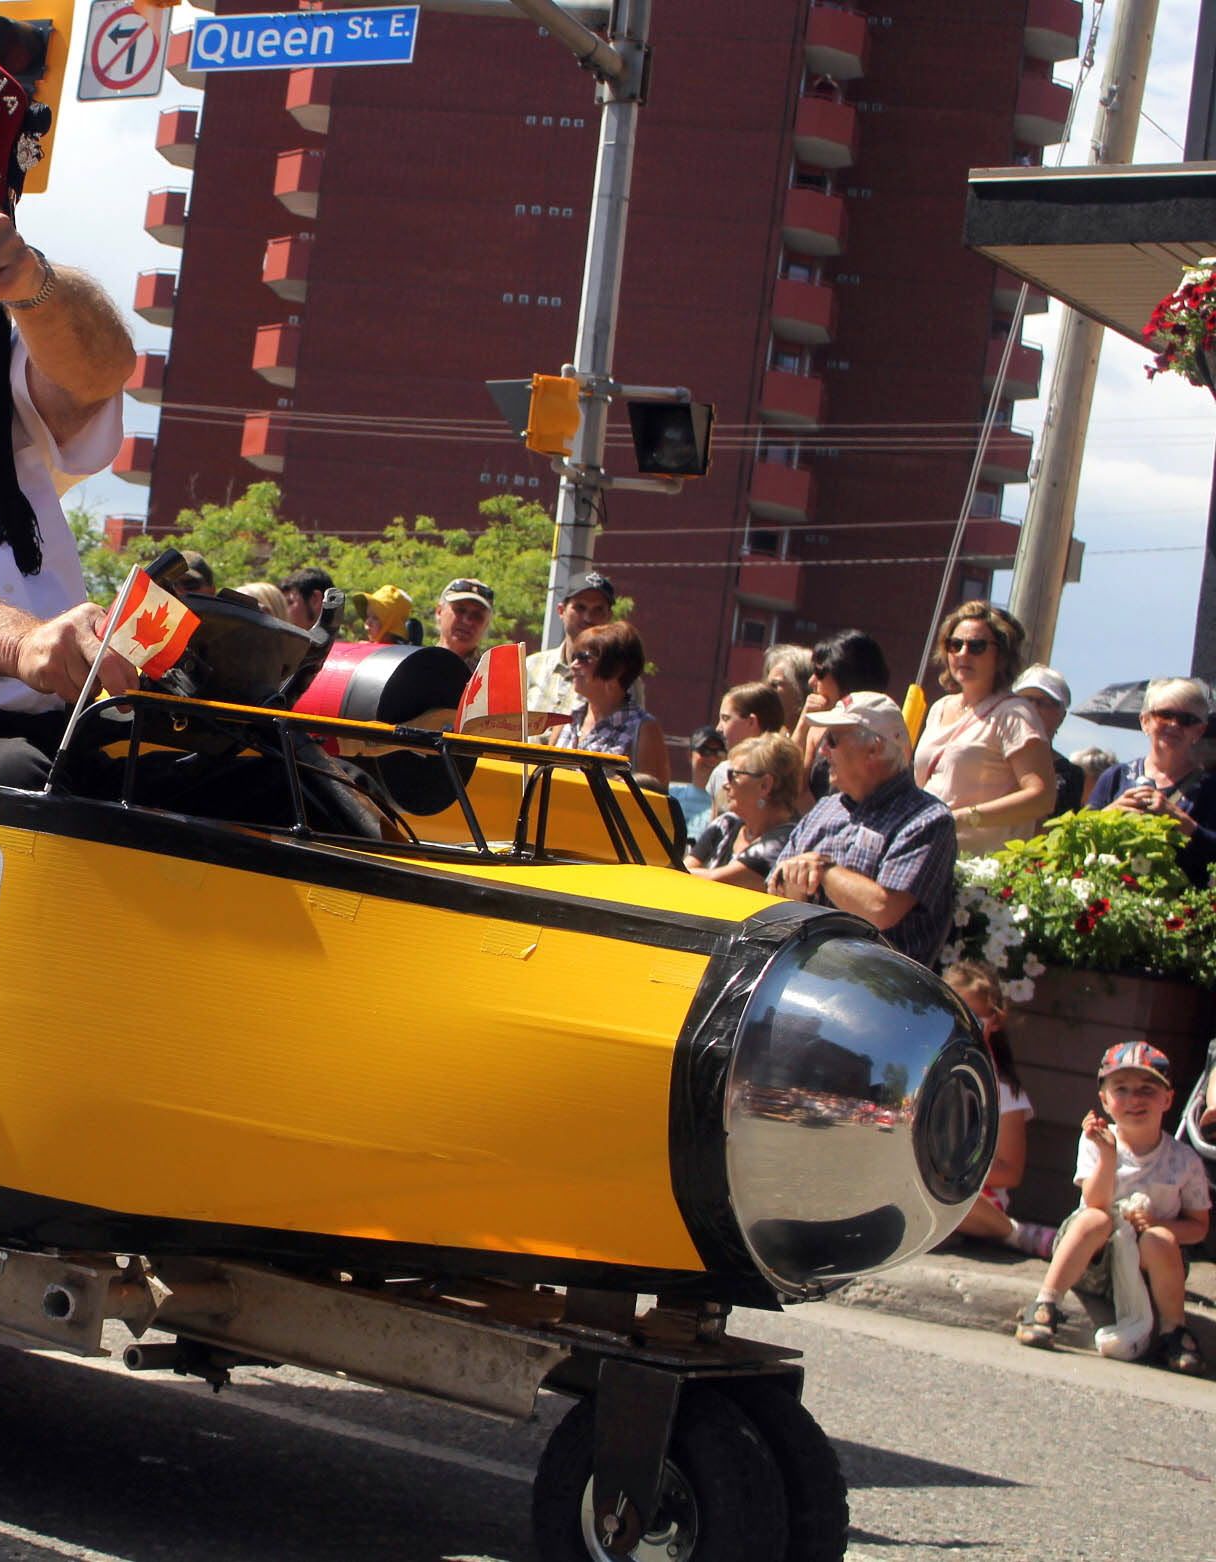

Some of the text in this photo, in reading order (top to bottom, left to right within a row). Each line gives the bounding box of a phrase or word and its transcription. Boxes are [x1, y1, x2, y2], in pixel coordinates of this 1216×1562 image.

[196, 14, 410, 64] Queen St. E.
